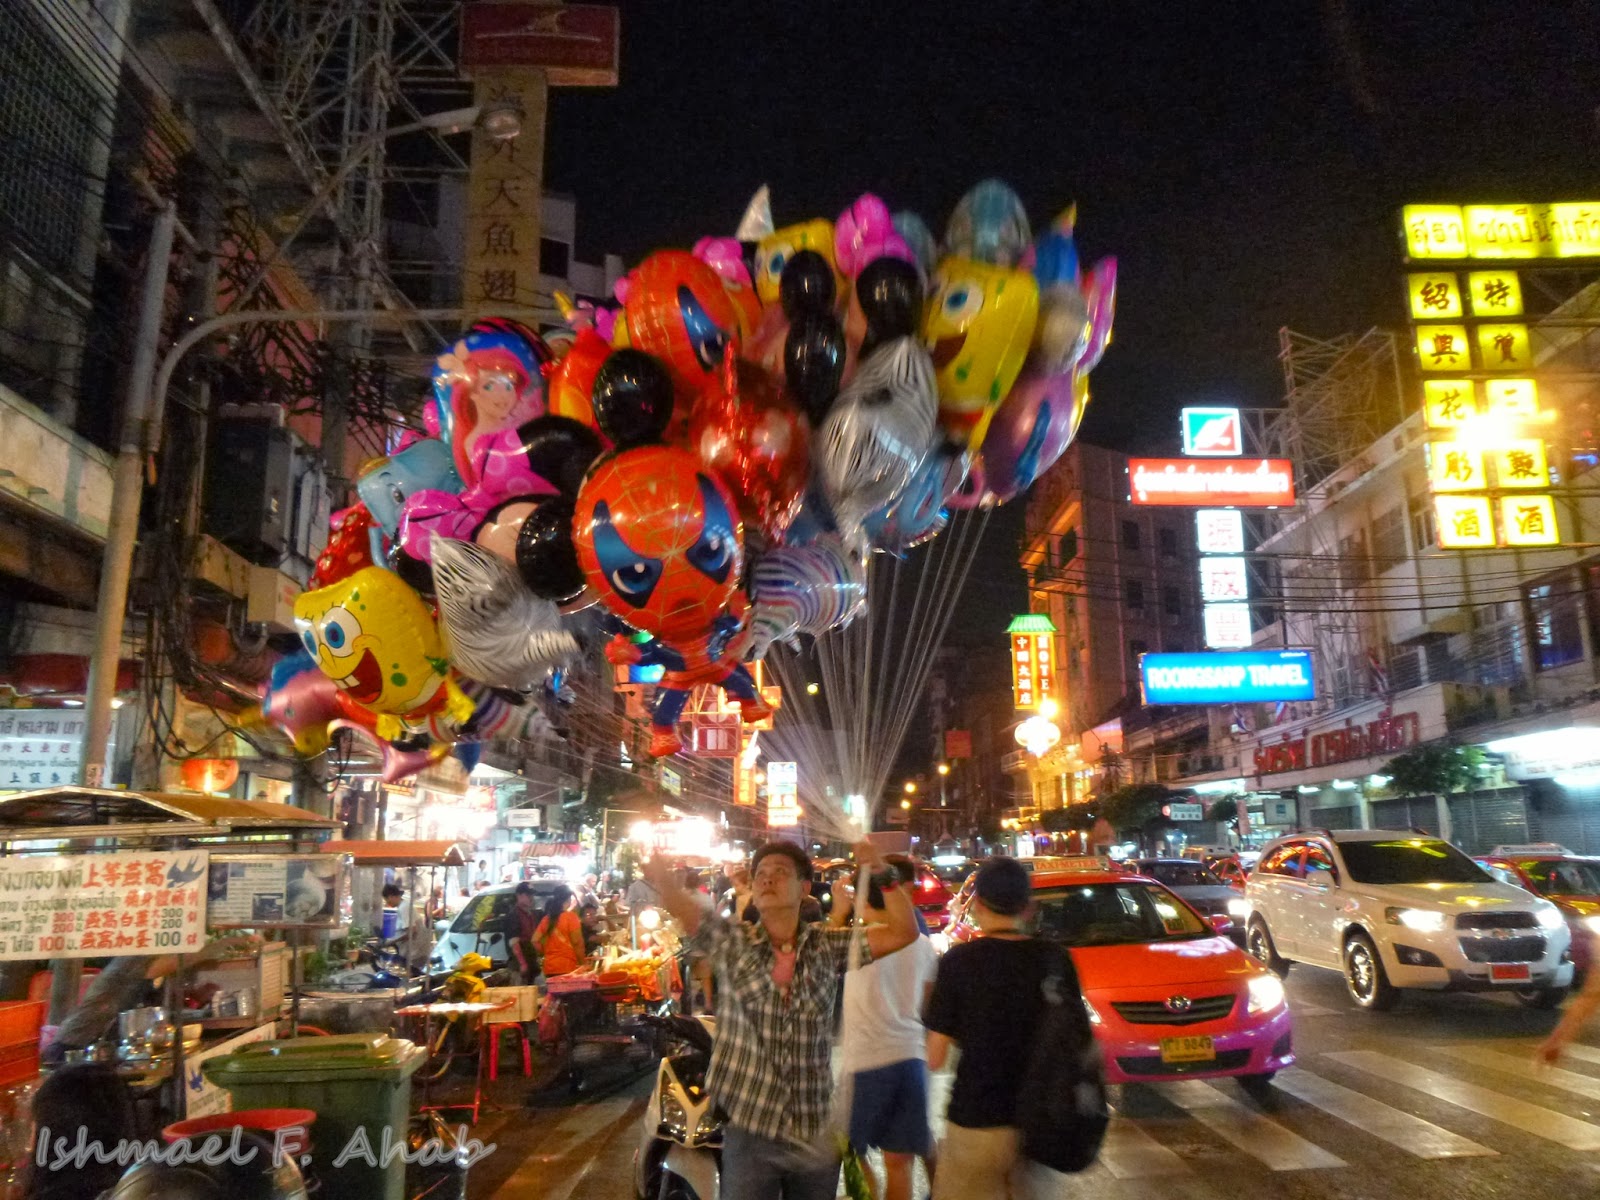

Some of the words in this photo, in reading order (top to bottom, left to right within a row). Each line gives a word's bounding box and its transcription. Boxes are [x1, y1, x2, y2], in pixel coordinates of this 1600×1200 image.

[1147, 665, 1246, 689] ROONGSARP
[1247, 663, 1309, 687] TRAVEL
[161, 907, 183, 919] 300
[52, 921, 74, 933] 200
[161, 918, 183, 930] 200
[38, 936, 65, 951] 100
[154, 931, 182, 947] 100
